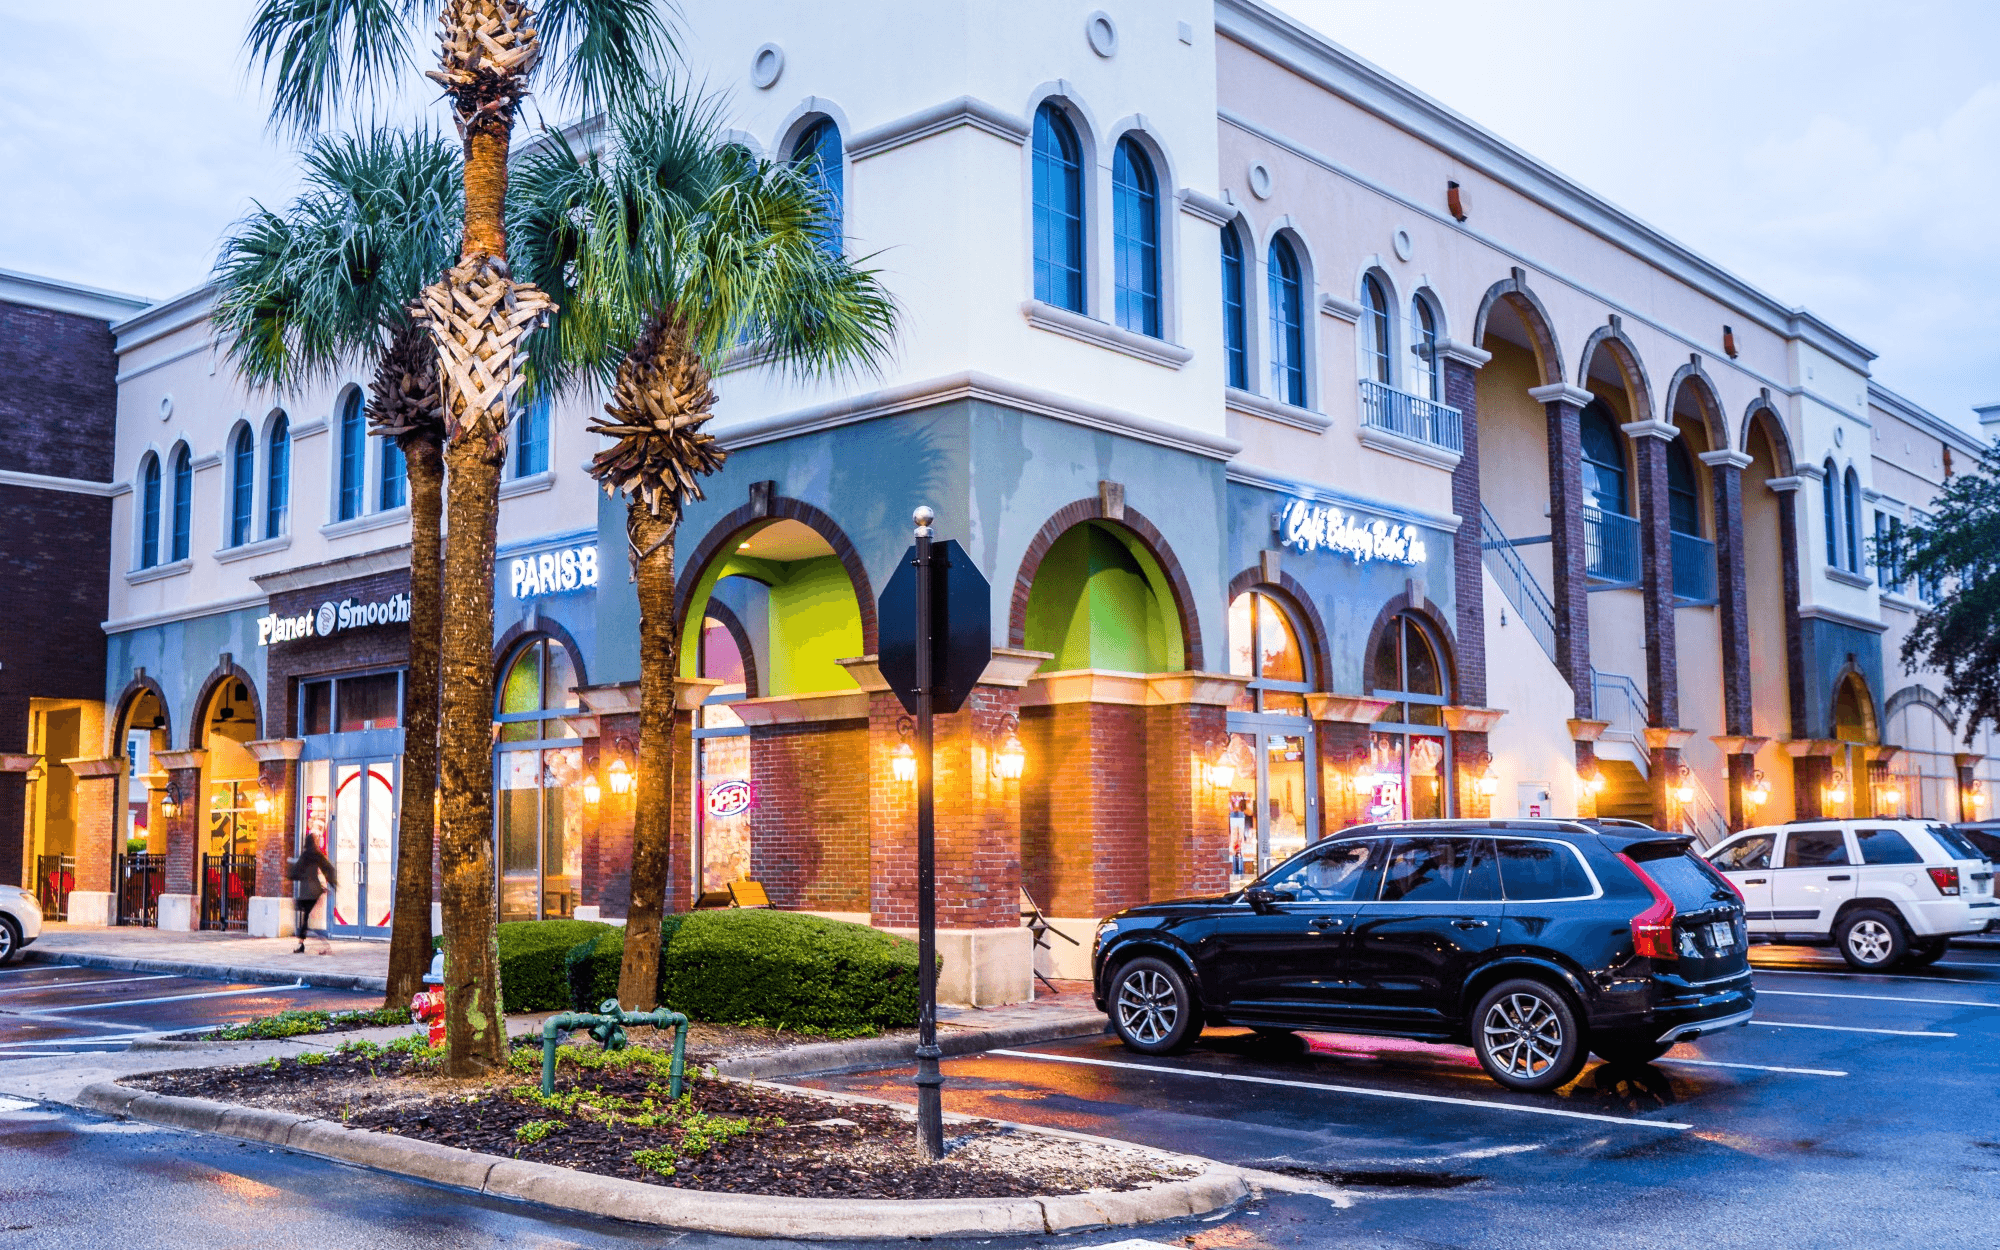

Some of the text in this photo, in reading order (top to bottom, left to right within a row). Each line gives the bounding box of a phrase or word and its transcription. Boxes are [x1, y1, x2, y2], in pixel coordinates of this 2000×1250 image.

[511, 549, 577, 598] PARIS
[257, 609, 314, 646] Planet
[708, 787, 750, 812] OPEN
